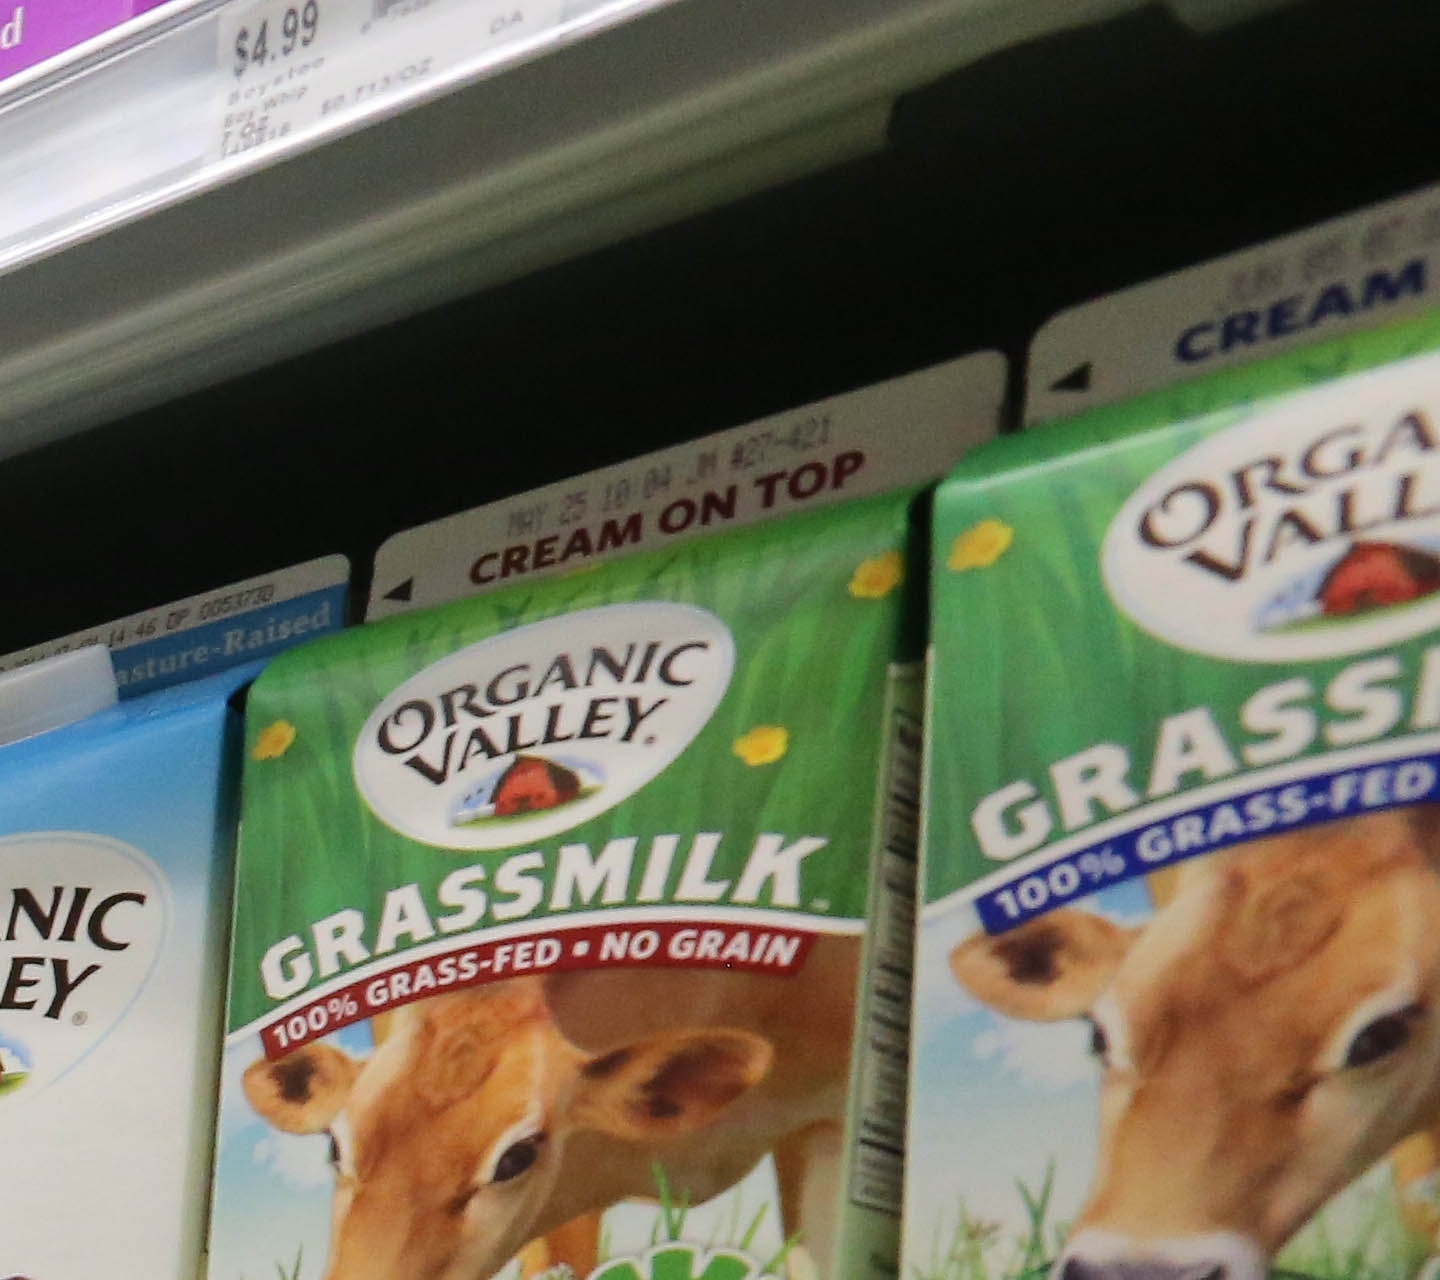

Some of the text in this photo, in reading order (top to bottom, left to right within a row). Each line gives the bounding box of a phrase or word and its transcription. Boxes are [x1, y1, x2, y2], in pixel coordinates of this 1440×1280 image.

[232, 3, 321, 80] $4.99
[1172, 258, 1430, 366] CREAM
[468, 520, 645, 588] CREAM
[656, 492, 736, 543] ON
[753, 450, 867, 529] TOP
[375, 640, 713, 761] ORGANIC
[403, 695, 670, 792] VALLEY
[991, 754, 1438, 921] 100% GRASS-FED
[261, 832, 830, 1006] GRASSMILK
[272, 927, 802, 1051] 100% GRASS-FED NO GRAIN
